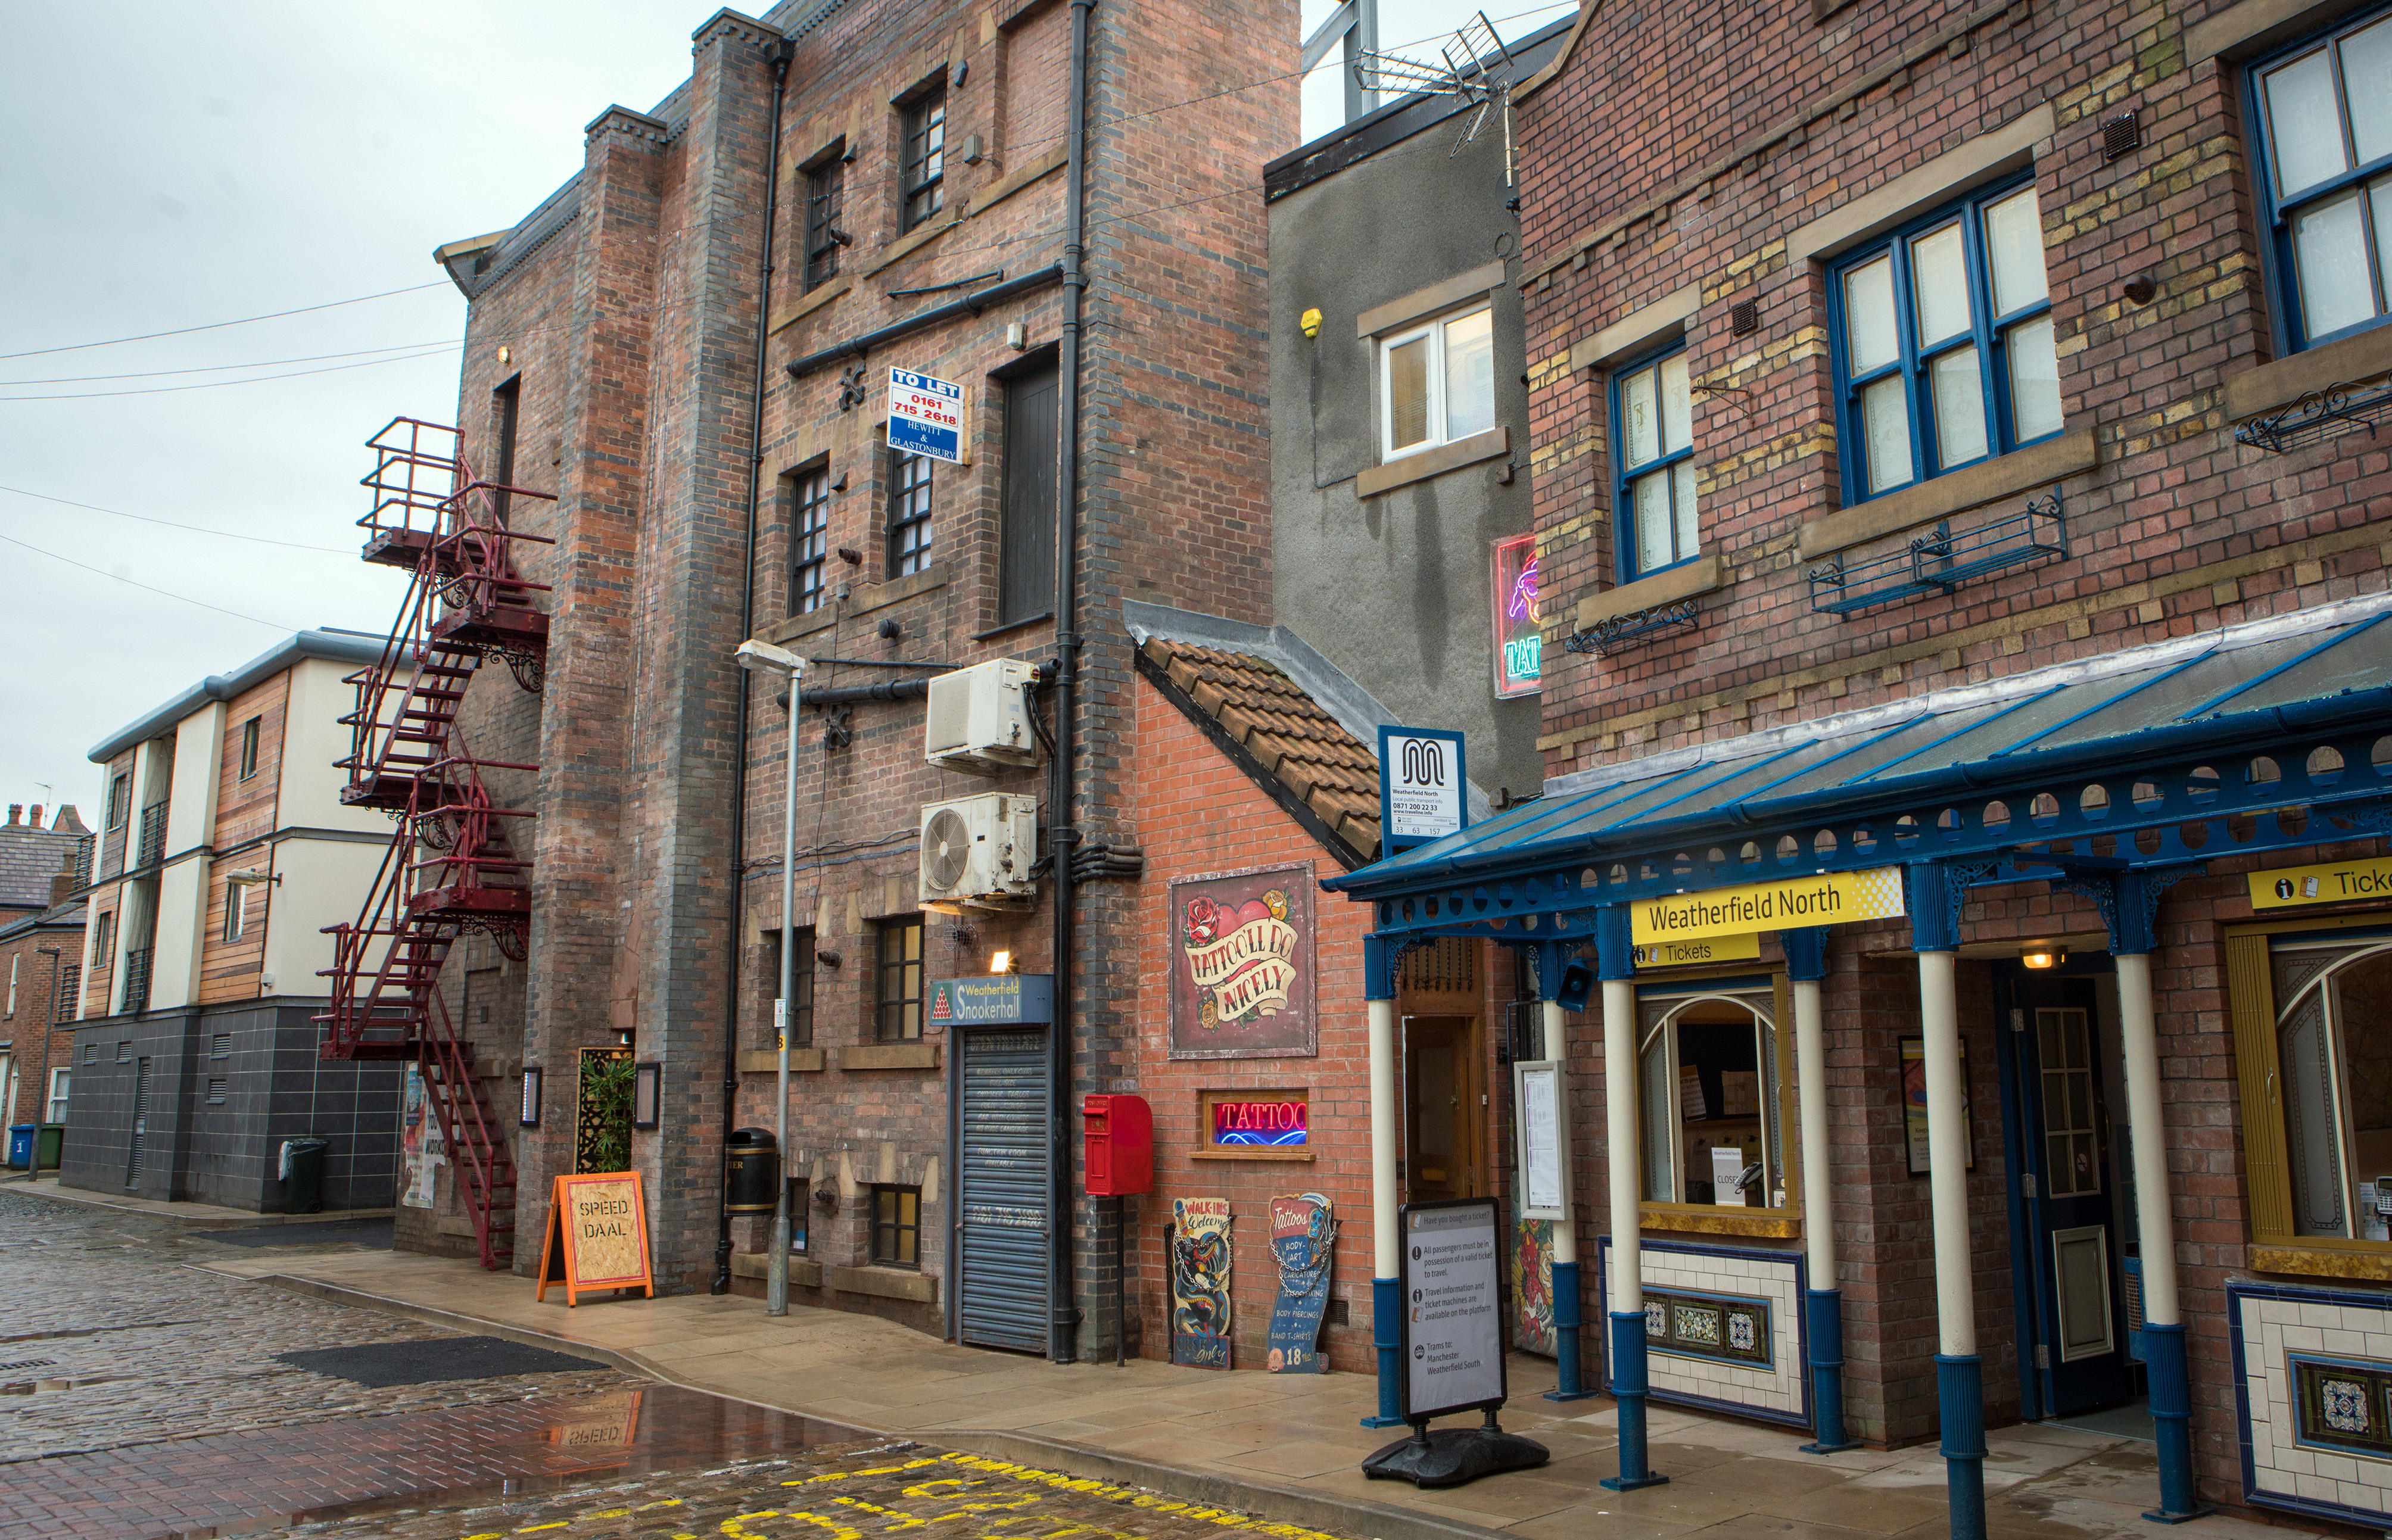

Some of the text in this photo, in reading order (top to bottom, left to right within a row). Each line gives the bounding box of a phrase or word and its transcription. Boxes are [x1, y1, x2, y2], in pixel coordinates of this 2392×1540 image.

[895, 370, 958, 397] TO LET
[911, 395, 942, 410] 0161
[895, 402, 957, 425] 715 2618
[908, 420, 942, 436] HEWITT
[920, 434, 927, 442] &
[890, 437, 955, 459] GLASTONBURY
[1649, 884, 1840, 931] Weatherfield North
[1192, 925, 1292, 978] TATTOO'LL DO
[1665, 943, 1711, 961] Tickets
[965, 981, 1019, 996] Weatherfield
[1223, 966, 1287, 1014] NICELY
[957, 985, 1019, 1020] Snookerhall
[1222, 1103, 1306, 1130] TATTOO
[17, 1142, 23, 1152] 1
[977, 1147, 1027, 1157] FUNCTION ROOM
[985, 1160, 1014, 1168] AVAILABLE
[1717, 1176, 1738, 1184] CLOSE
[580, 1201, 628, 1216] SPEED
[1274, 1207, 1309, 1230] Tattoos
[1424, 1216, 1437, 1224] Have
[1438, 1217, 1448, 1226] you
[1449, 1214, 1468, 1223] bought
[1472, 1211, 1490, 1220] ticket?
[585, 1222, 627, 1238] DAAL
[1285, 1241, 1306, 1251] BODY-
[1424, 1246, 1432, 1254] All
[1432, 1244, 1462, 1255] passengers
[1289, 1252, 1303, 1261] ART
[1424, 1257, 1453, 1268] possession
[1465, 1253, 1477, 1261] valid
[1478, 1252, 1493, 1260] ticket
[1431, 1268, 1449, 1277] travel.
[1425, 1282, 1484, 1296] Travel information and
[1425, 1300, 1441, 1308] ticket
[1442, 1297, 1468, 1307] machines
[1292, 1310, 1319, 1318] PIERCINGS
[1425, 1310, 1450, 1321] available
[1459, 1308, 1468, 1316] the
[1469, 1305, 1491, 1316] platform
[1287, 1332, 1311, 1341] T-SHIRTS
[1178, 1338, 1207, 1352] CASH
[1427, 1342, 1444, 1351] Trams
[1192, 1345, 1226, 1366] Only
[1287, 1348, 1301, 1366] 18
[1427, 1352, 1459, 1363] Manchester
[1427, 1360, 1480, 1375] Weatherfield South
